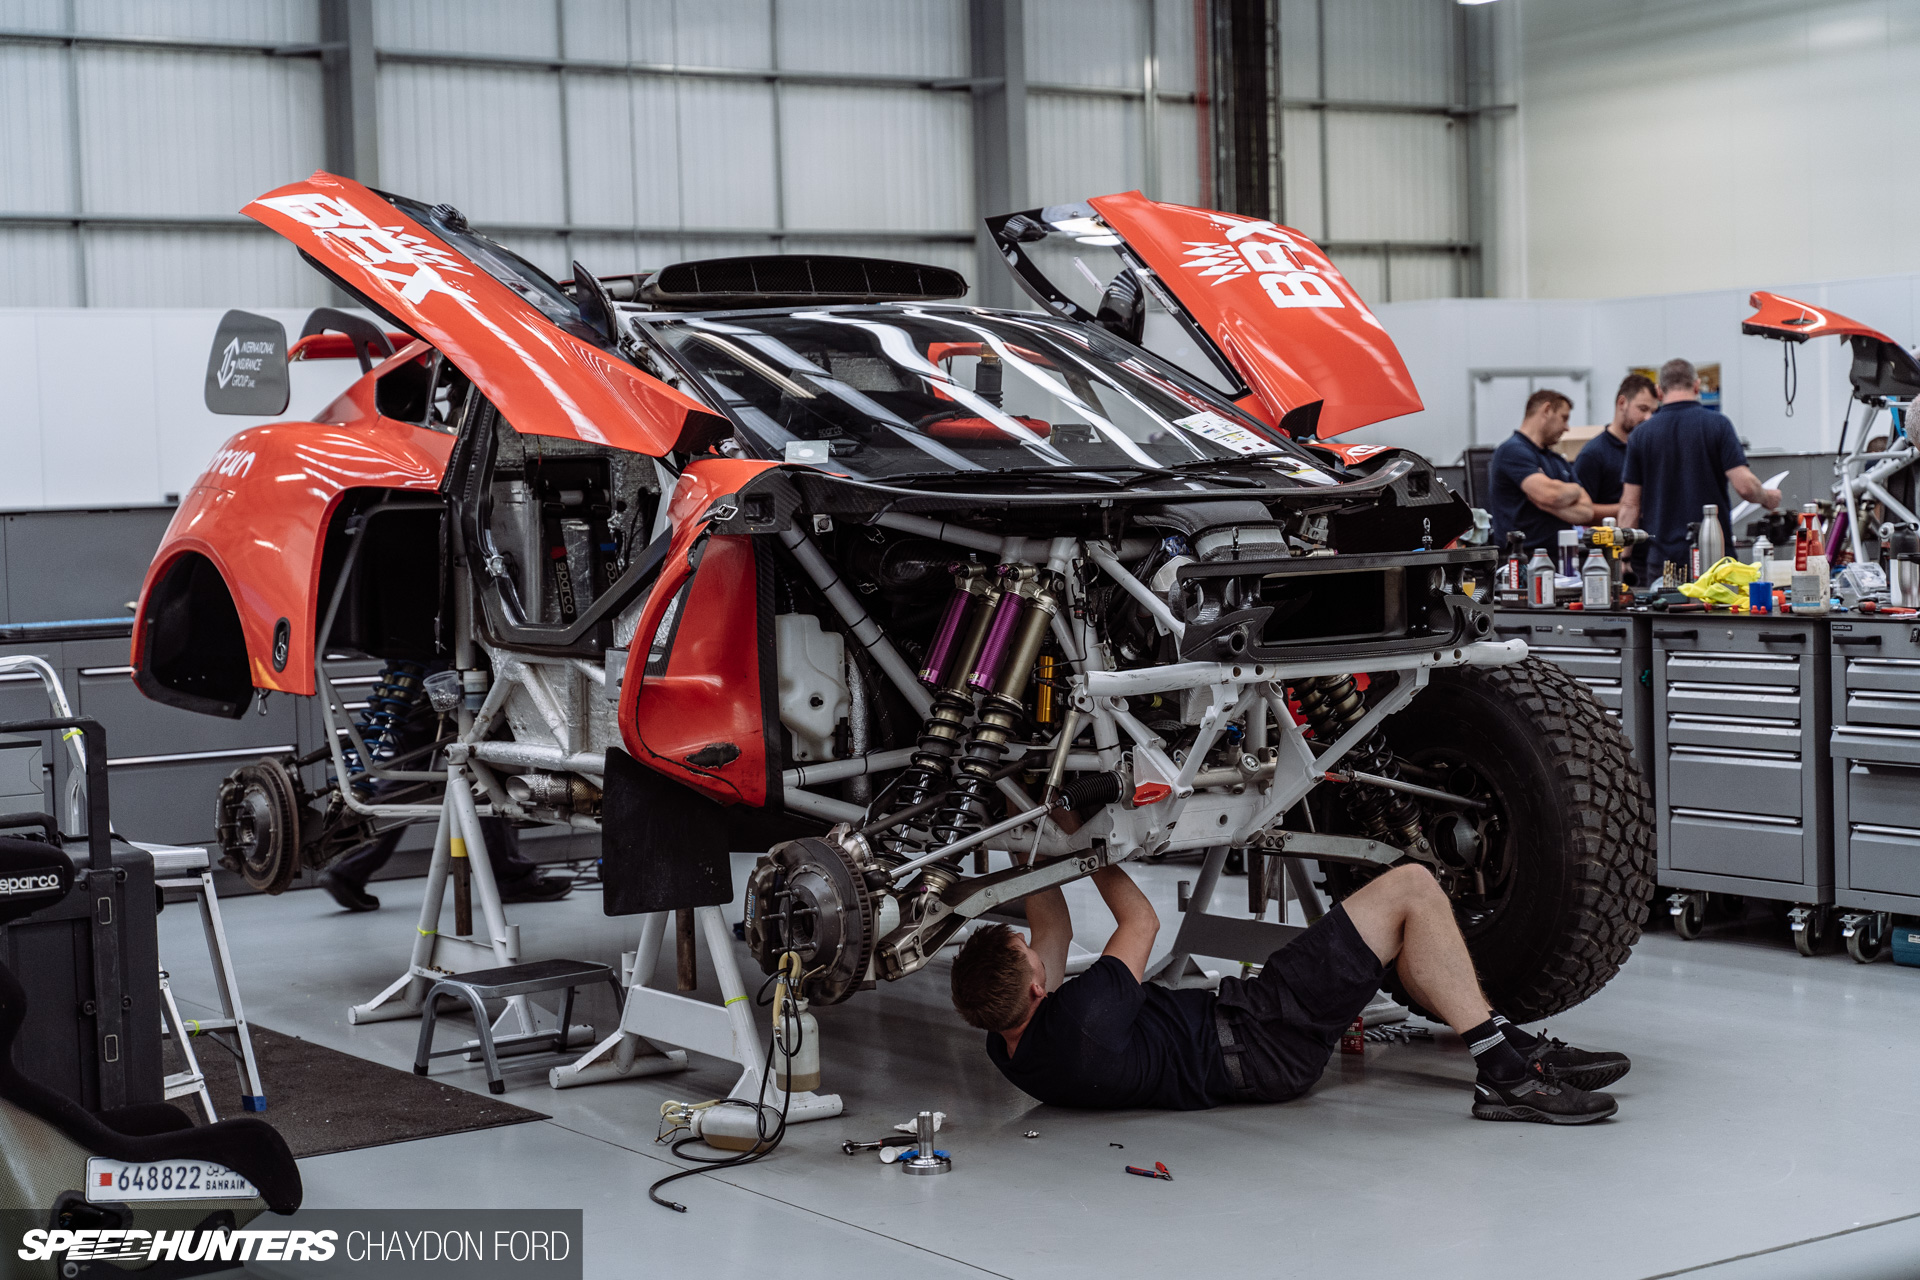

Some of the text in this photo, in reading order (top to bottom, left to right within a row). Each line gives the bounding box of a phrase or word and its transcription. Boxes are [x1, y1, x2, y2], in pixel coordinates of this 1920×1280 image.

[255, 193, 478, 305] BRX
[1209, 213, 1346, 309] BRX
[240, 341, 275, 355] INTERNATIONAL
[235, 358, 263, 371] INSURANCE
[231, 374, 250, 387] GROUP
[605, 562, 620, 586] rco
[1510, 560, 1519, 590] MOTUL
[555, 562, 575, 614] sparco
[0, 874, 60, 895] sparco
[118, 1166, 201, 1191] 648822
[205, 1179, 246, 1191] BAHRAIN
